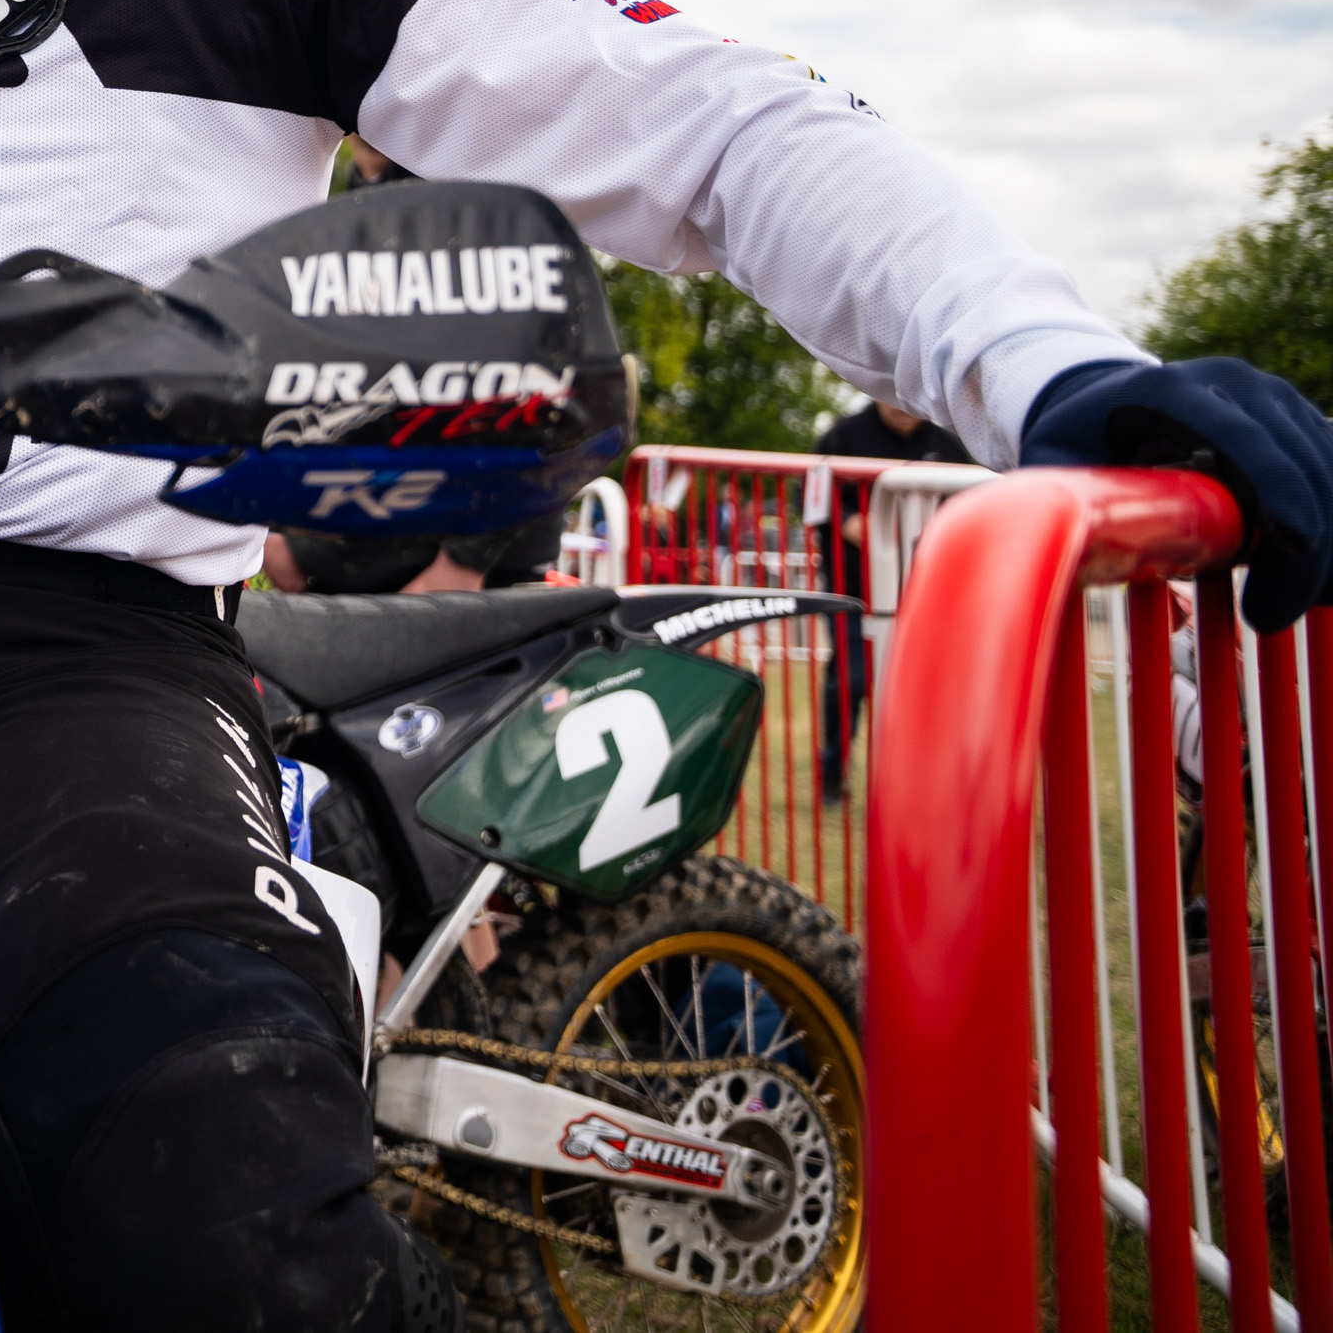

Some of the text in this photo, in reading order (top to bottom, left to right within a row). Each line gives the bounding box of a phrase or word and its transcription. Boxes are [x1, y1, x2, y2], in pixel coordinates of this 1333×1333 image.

[280, 243, 570, 317] YAMALUBE
[653, 596, 798, 645] MICHELIN
[555, 688, 682, 874] 2
